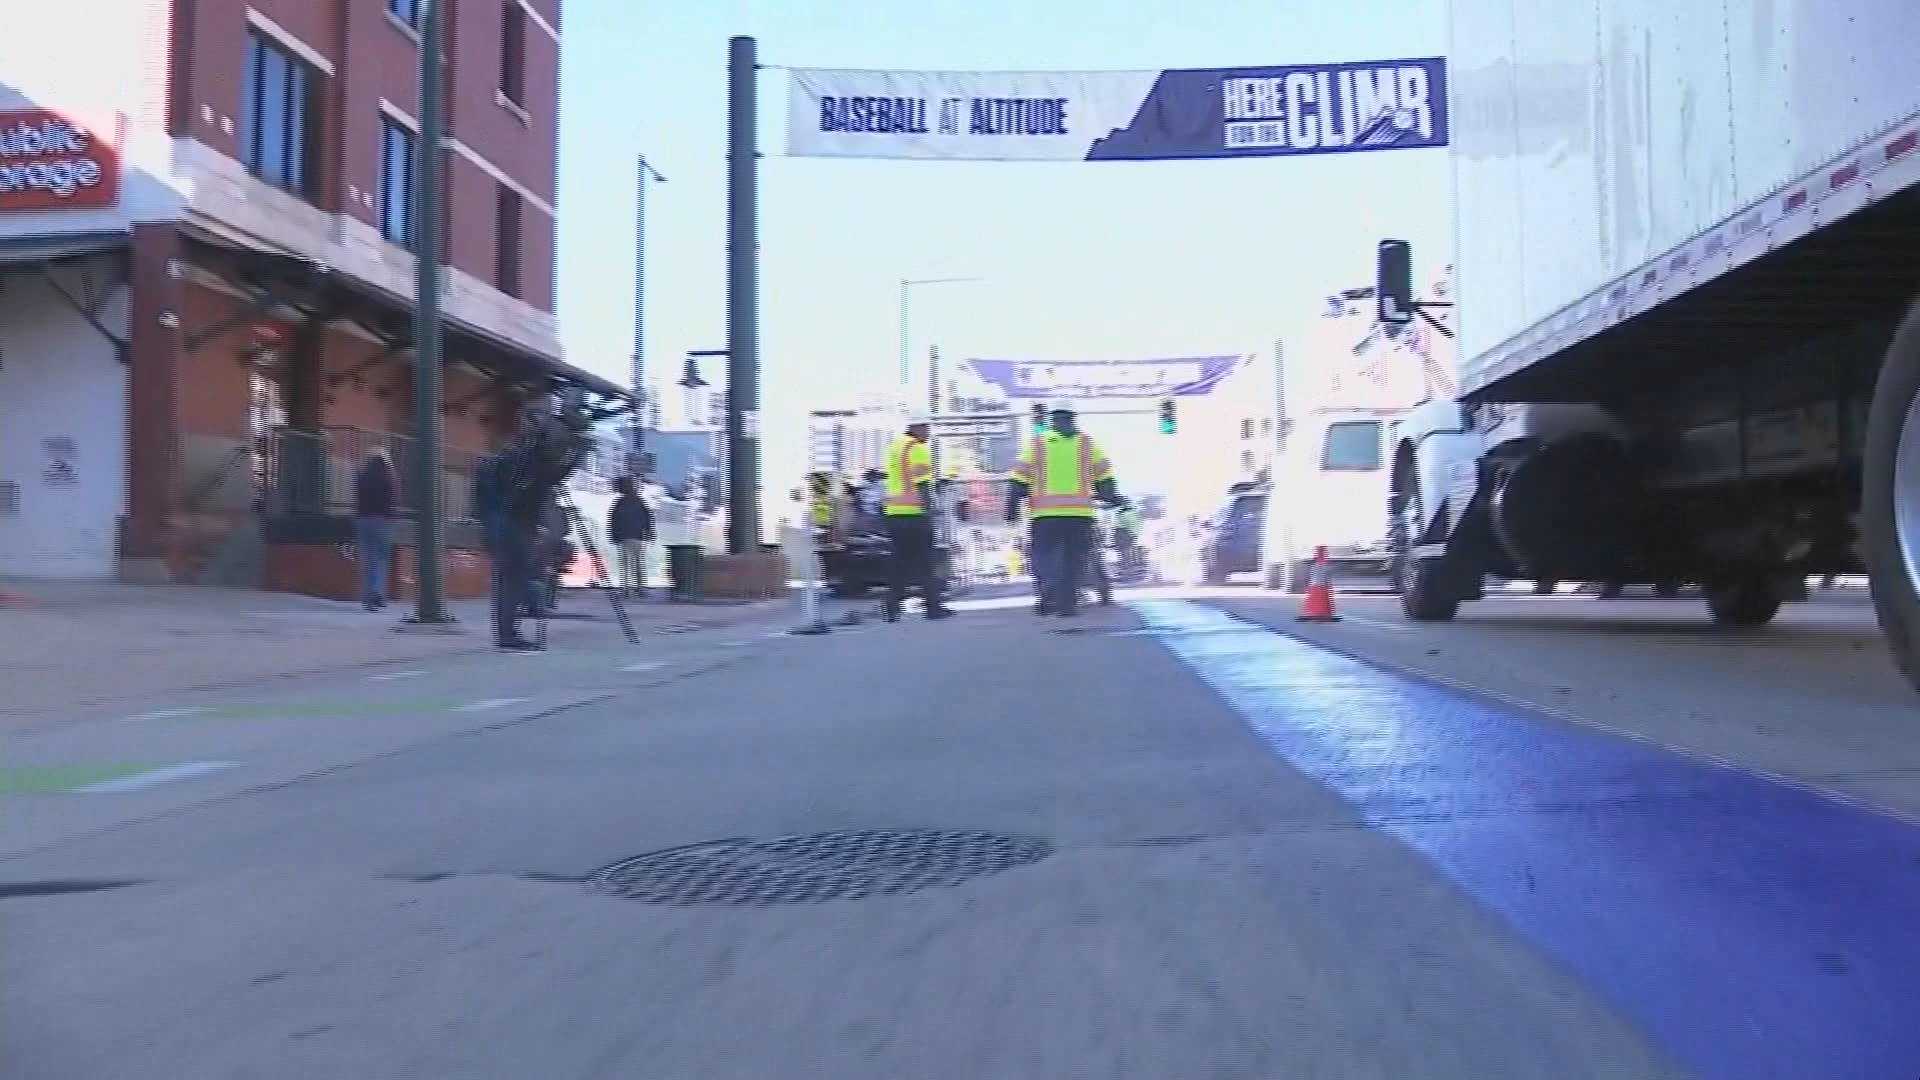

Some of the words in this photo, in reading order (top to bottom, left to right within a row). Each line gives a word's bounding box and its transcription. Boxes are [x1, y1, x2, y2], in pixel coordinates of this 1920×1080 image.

[821, 96, 929, 133] BASEBALL
[938, 98, 962, 135] AT
[969, 97, 1069, 135] ALTITUDE
[1223, 78, 1285, 119] HERE
[1286, 67, 1431, 148] CLIMB
[1230, 124, 1256, 143] FOR
[1259, 123, 1280, 142] THE
